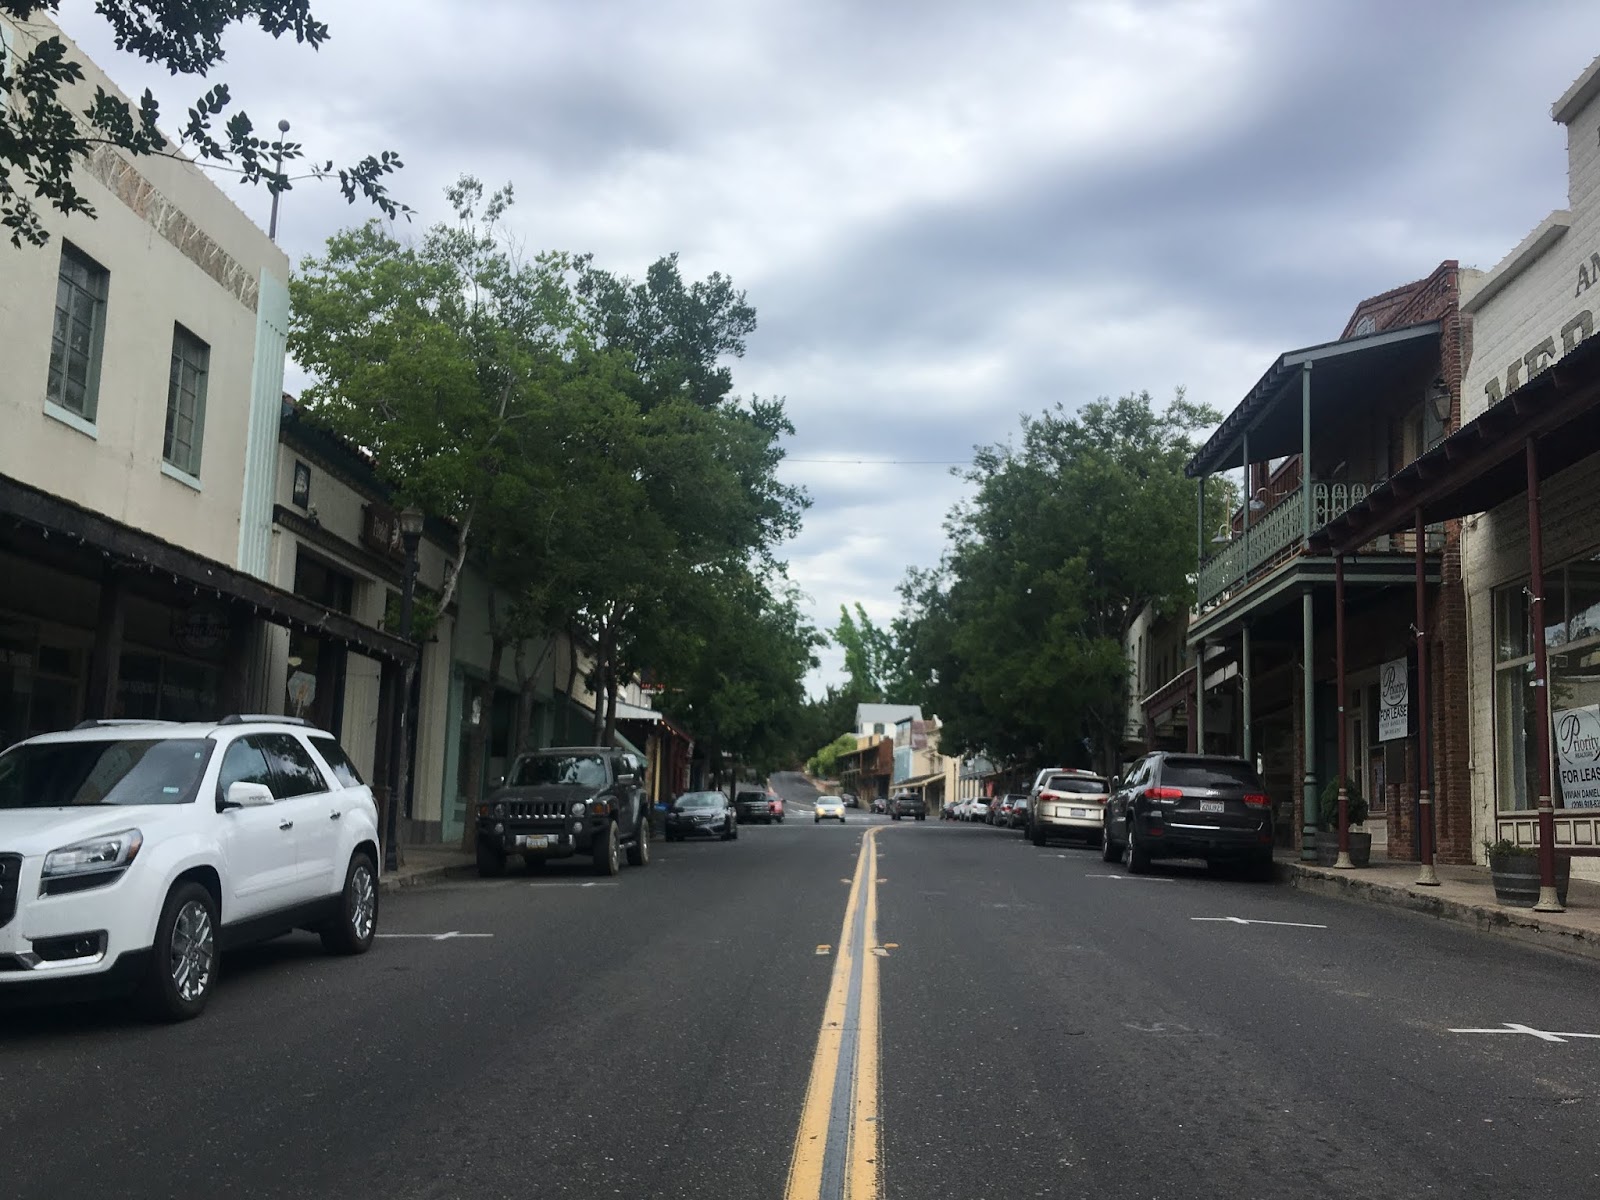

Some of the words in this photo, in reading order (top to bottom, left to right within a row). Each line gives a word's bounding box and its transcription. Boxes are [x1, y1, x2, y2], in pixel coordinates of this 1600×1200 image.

[1380, 709, 1391, 720] FOR
[1391, 704, 1407, 719] LEASE
[1561, 714, 1600, 754] Priority
[1562, 769, 1579, 783] FOR
